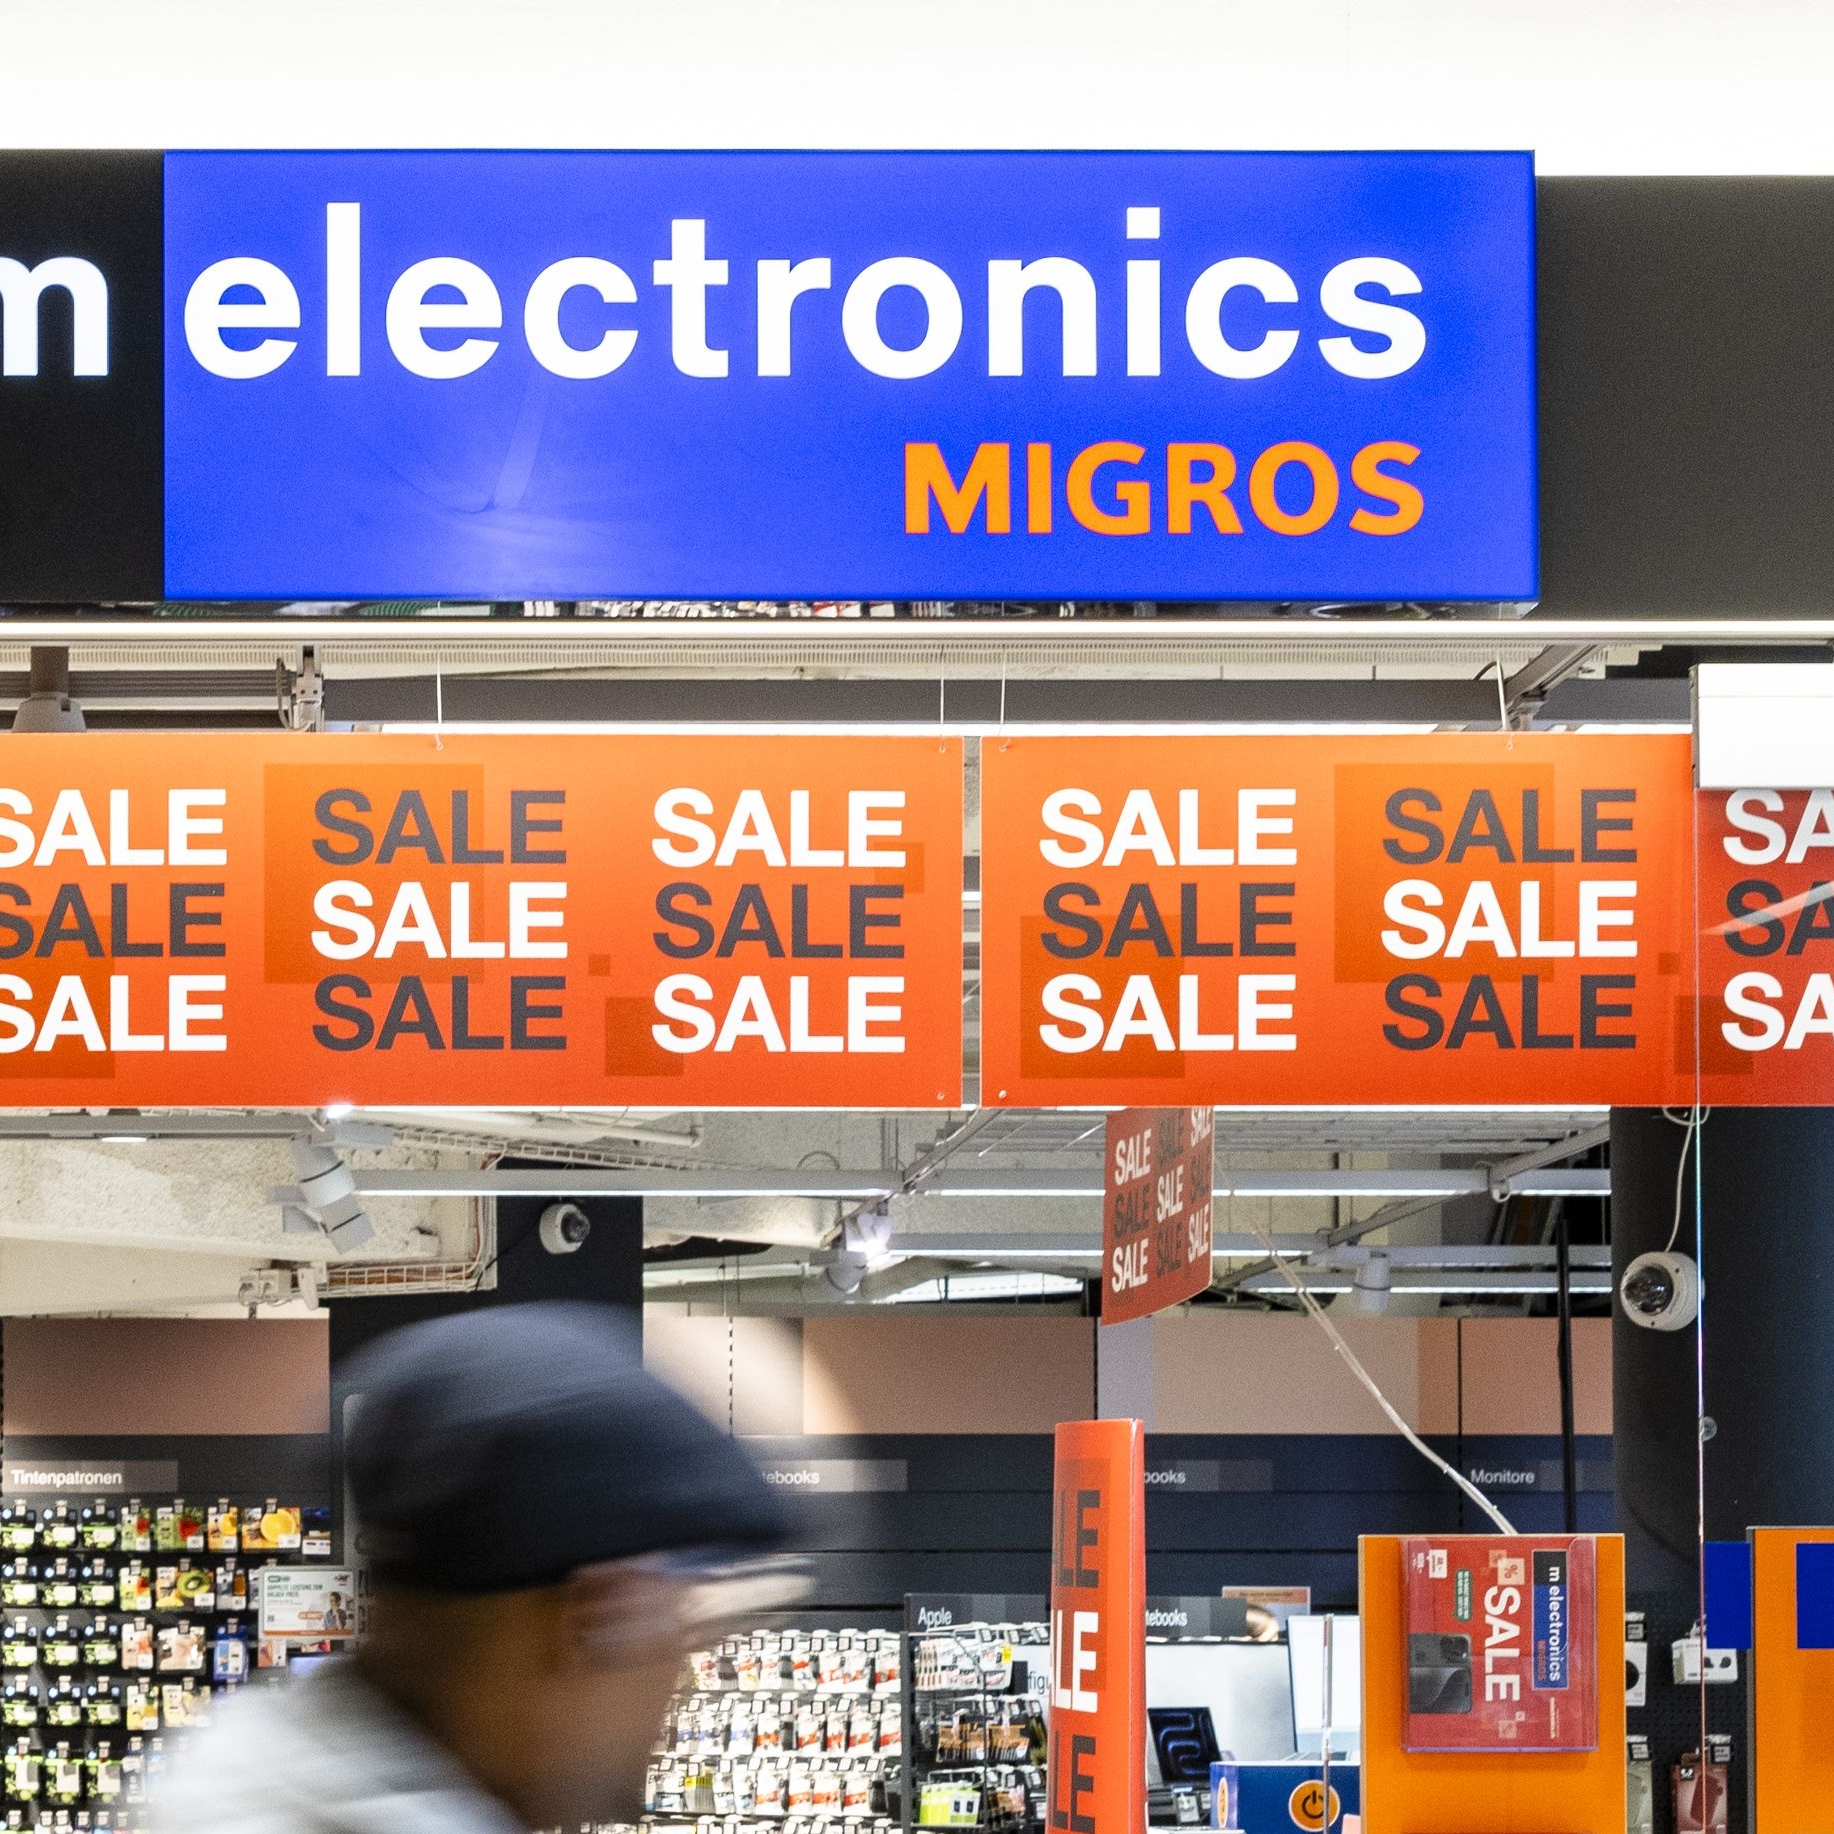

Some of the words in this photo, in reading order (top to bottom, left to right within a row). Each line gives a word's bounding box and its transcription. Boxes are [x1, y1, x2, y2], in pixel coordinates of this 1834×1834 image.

[180, 201, 1429, 381] electronics
[903, 438, 1427, 539] MIGROS
[310, 788, 568, 868] SALE
[651, 787, 907, 869] SALE
[1038, 787, 1298, 869] SALE
[1380, 787, 1638, 867] SALE
[310, 880, 568, 961] SALE
[651, 881, 906, 961] SALE
[1039, 881, 1297, 961] SALE
[1380, 879, 1638, 961] SALE
[311, 974, 567, 1053] SALE
[651, 973, 906, 1054] SALE
[1038, 973, 1298, 1054] SALE
[1380, 973, 1638, 1052] SALE
[1114, 1128, 1153, 1186] SALE
[1156, 1165, 1185, 1224] SALE
[1111, 1238, 1150, 1293] SALE
[1187, 1203, 1210, 1264] SALE
[11, 1467, 123, 1490] Tintenpatronen
[1470, 1468, 1535, 1484] Monitore
[917, 1606, 952, 1628] Apple
[1483, 1586, 1522, 1702] SALE
[1548, 1586, 1568, 1682] electronics
[1050, 1610, 1099, 1713] LE
